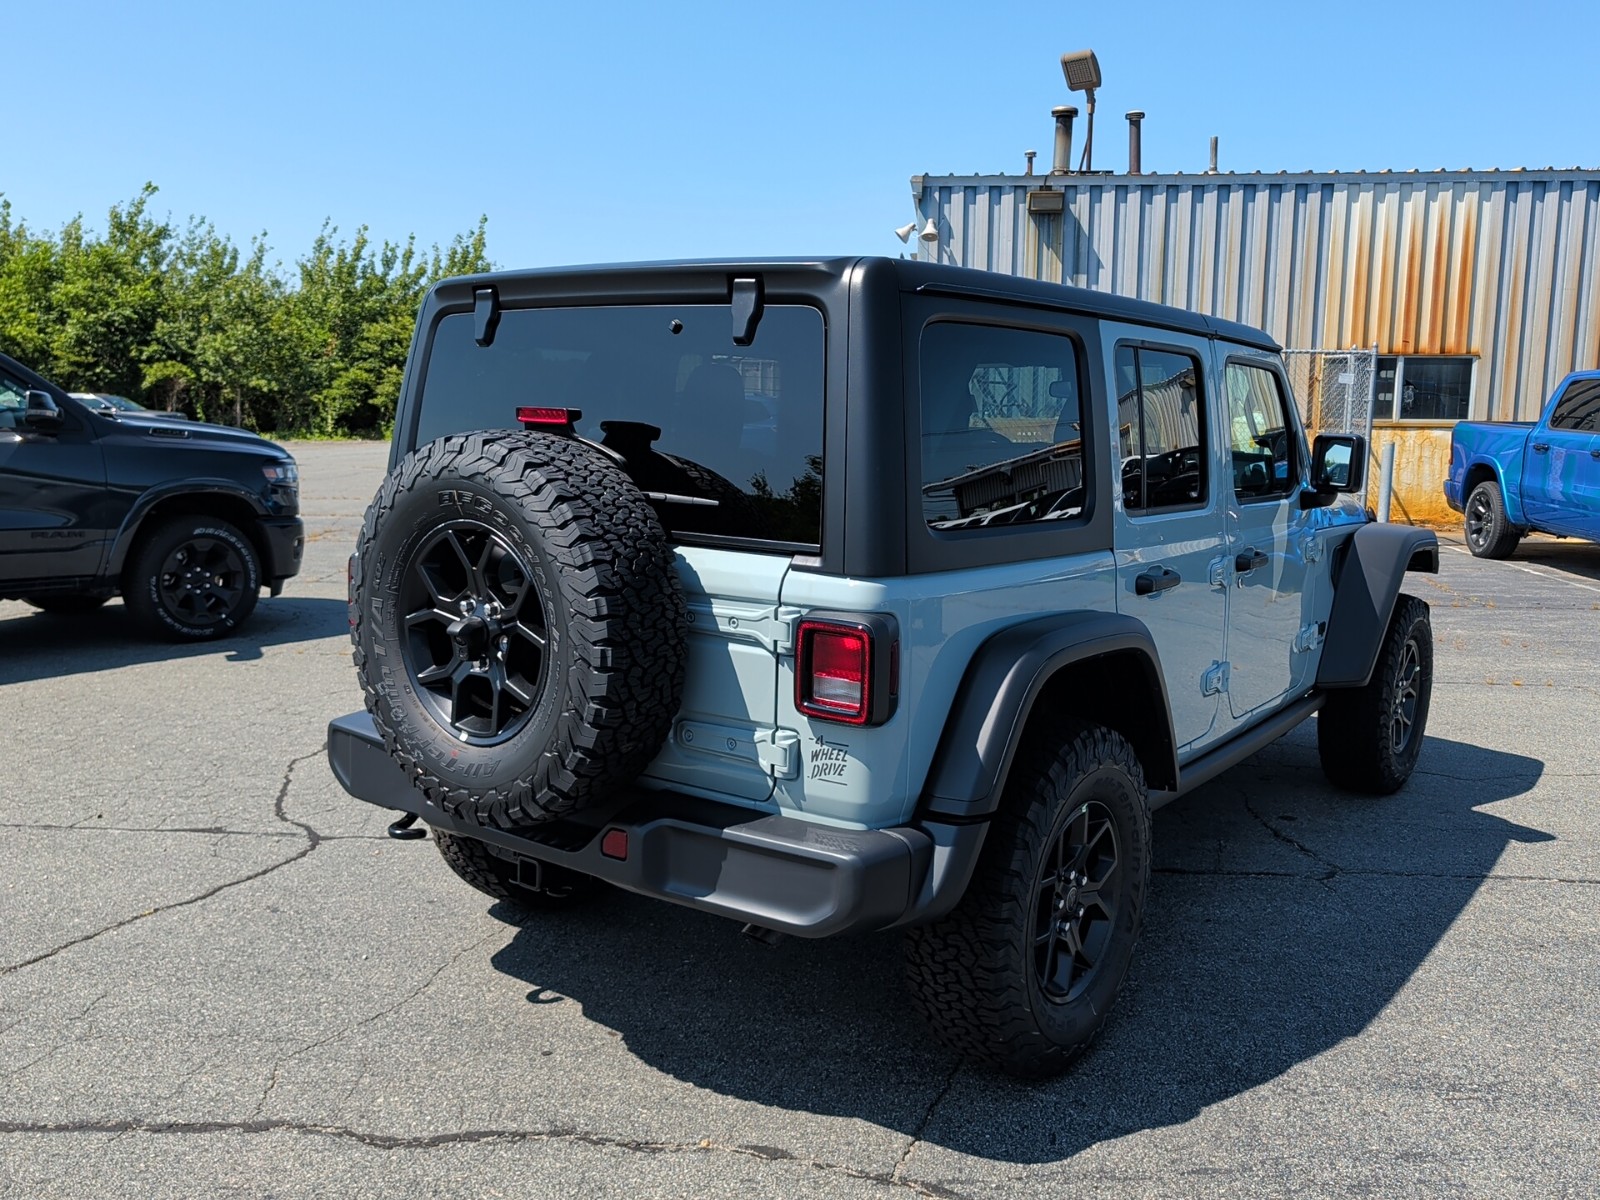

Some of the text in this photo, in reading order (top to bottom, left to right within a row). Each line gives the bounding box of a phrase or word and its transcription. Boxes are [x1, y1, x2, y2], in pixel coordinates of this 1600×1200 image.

[31, 531, 85, 539] RAM
[815, 735, 825, 747] 4
[811, 748, 848, 763] WHEEL
[811, 763, 847, 780] DRIVE
